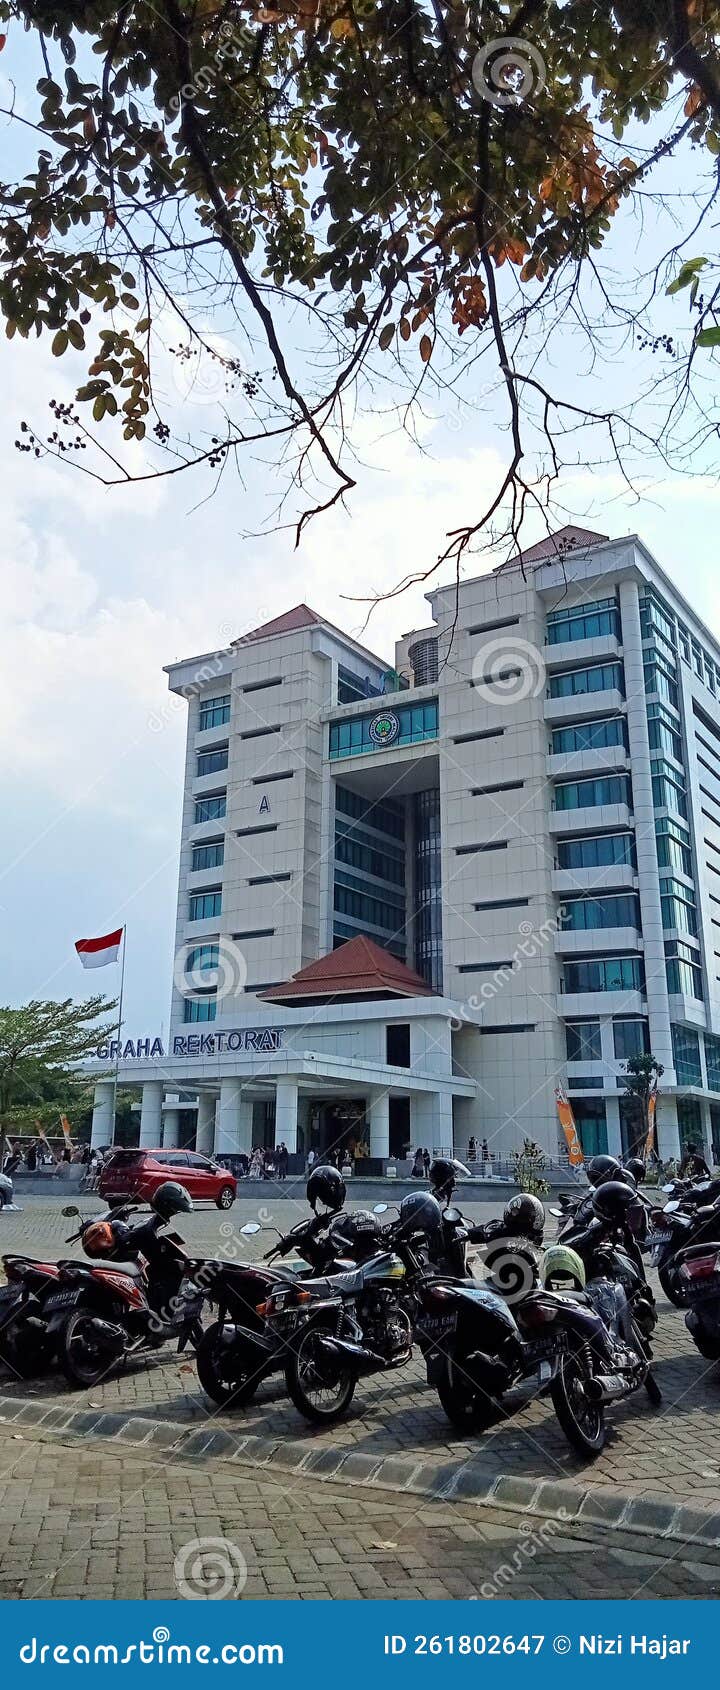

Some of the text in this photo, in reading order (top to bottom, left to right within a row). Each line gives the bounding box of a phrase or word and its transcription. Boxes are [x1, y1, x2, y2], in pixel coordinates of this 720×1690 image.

[259, 795, 271, 814] A
[97, 1029, 286, 1059] GRAHA REKTORAT
